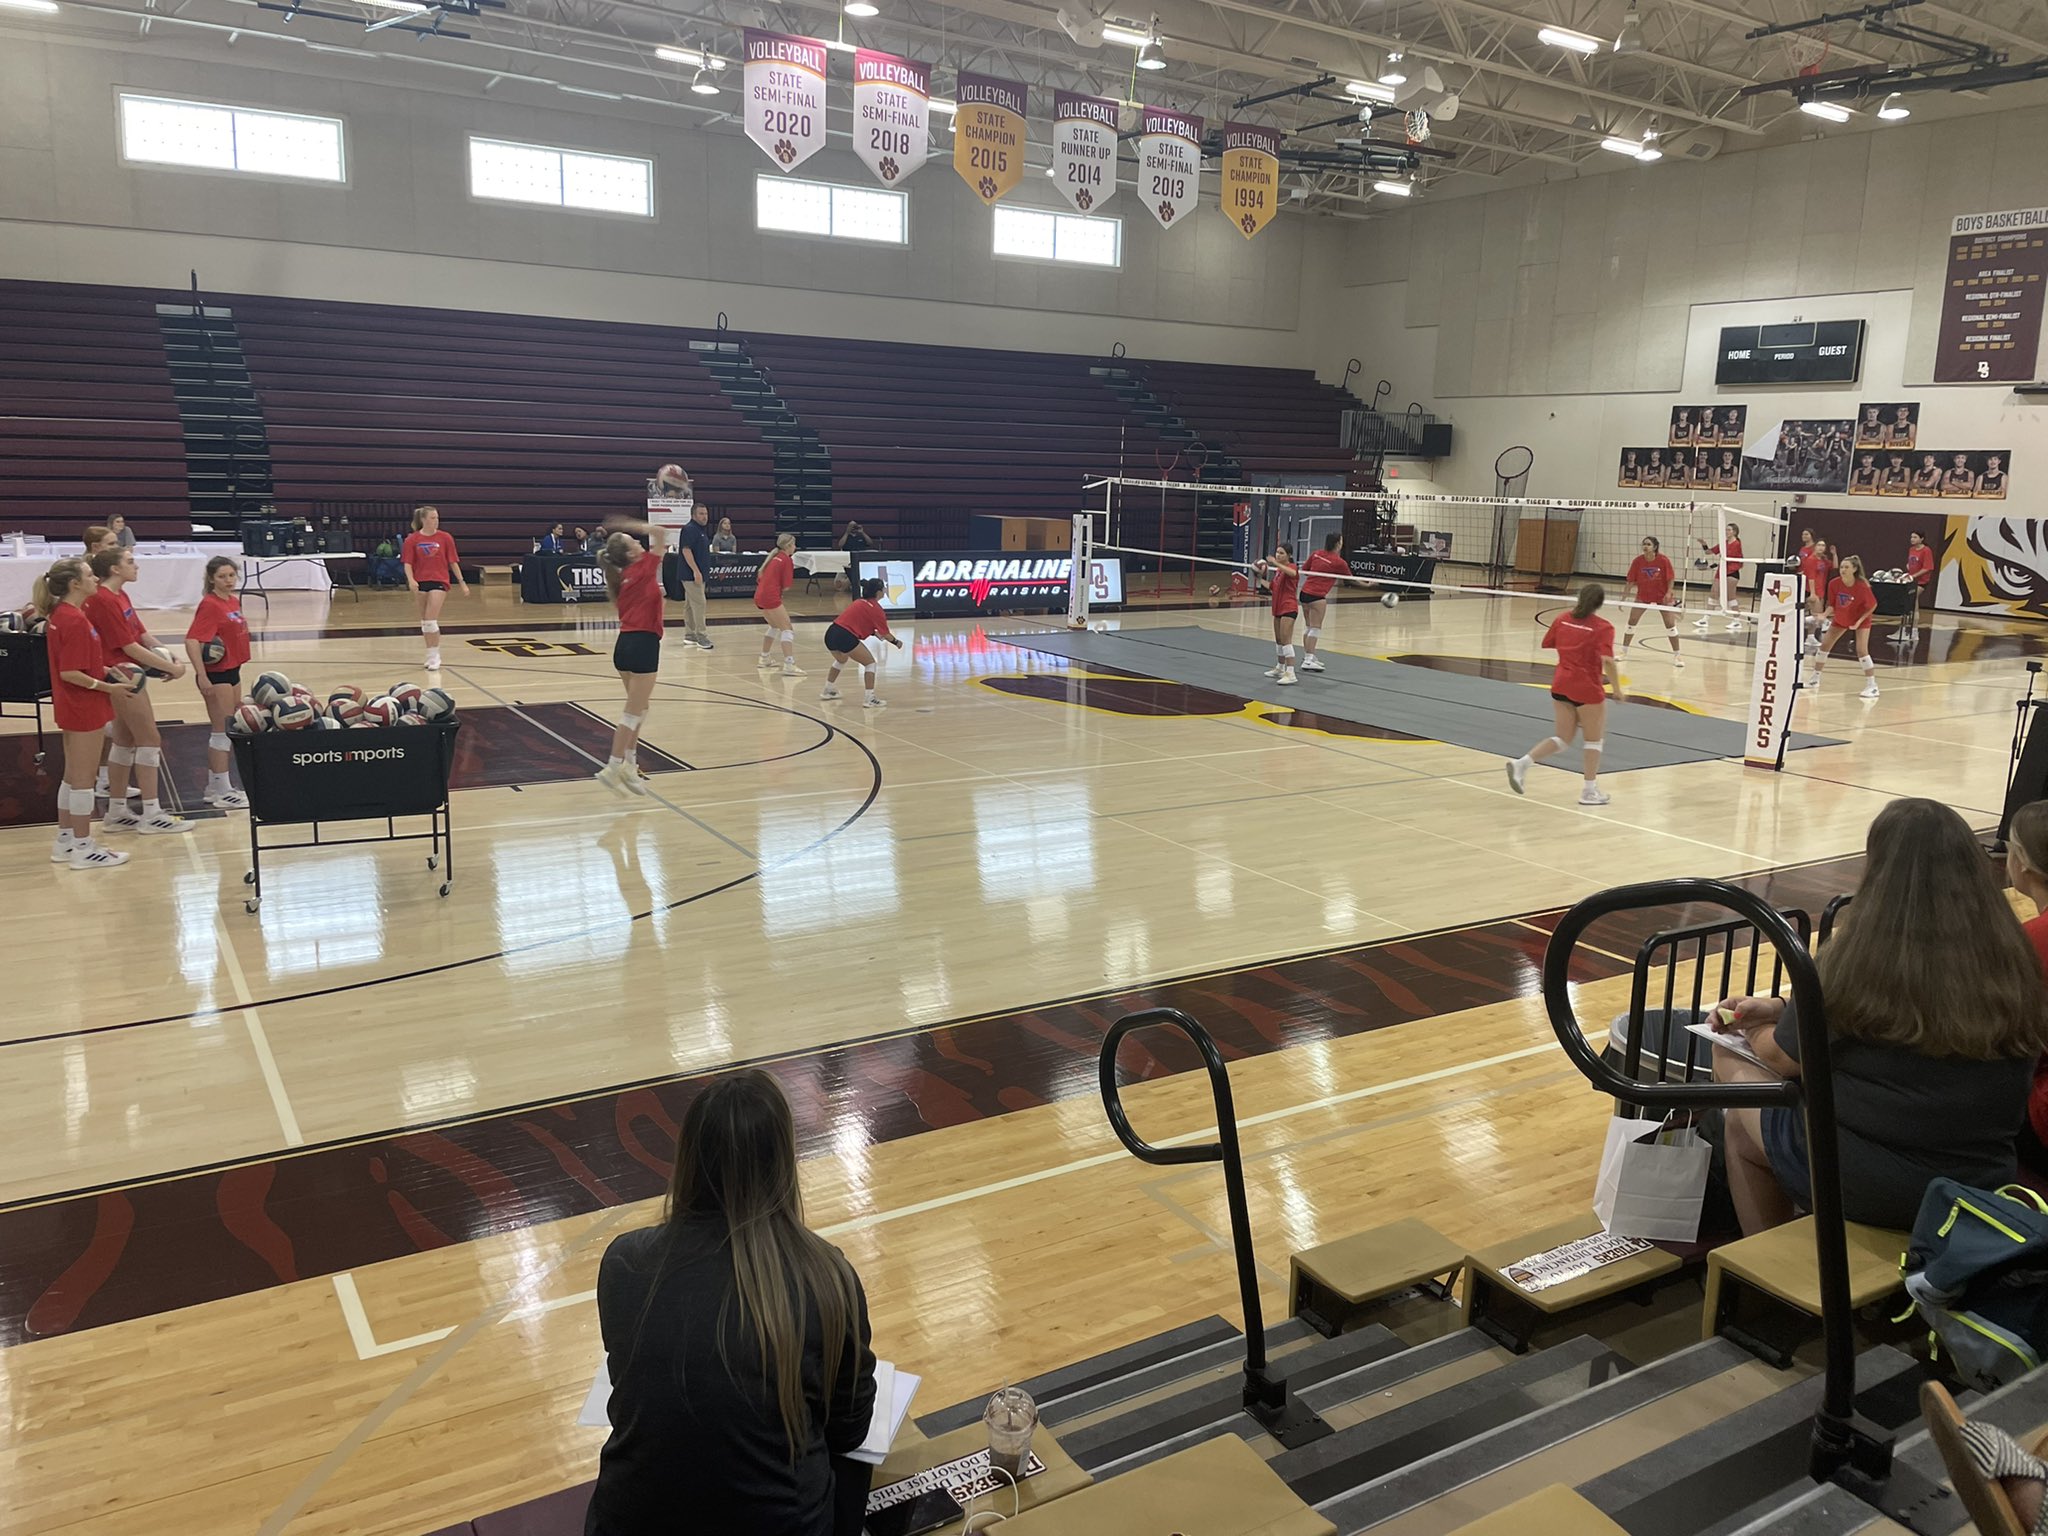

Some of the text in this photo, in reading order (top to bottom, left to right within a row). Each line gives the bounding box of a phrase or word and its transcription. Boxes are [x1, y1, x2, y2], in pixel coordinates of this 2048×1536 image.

[750, 41, 822, 72] VOLLEYBALL
[769, 70, 802, 90] STATE
[860, 62, 926, 94] VOLLEYBALL
[754, 86, 817, 109] SEMI-FINAL
[876, 92, 907, 110] STATE
[960, 84, 1022, 114] VOLLEYBALL
[764, 109, 811, 138] 2020
[862, 105, 920, 128] SEMI-FINAL
[977, 112, 1005, 128] STATE
[1058, 102, 1115, 128] VOLLEYBALL
[966, 125, 1016, 146] CHAMPION
[1073, 128, 1098, 144] STATE
[1146, 117, 1199, 144] VOLLEYBALL
[870, 128, 910, 155] 2018
[1062, 142, 1110, 160] RUNNER UP
[1159, 142, 1184, 158] STATE
[1226, 132, 1276, 156] VOLLEYBALL
[971, 146, 1007, 172] 2015
[1146, 156, 1194, 175] SEMI-FINAL
[1240, 156, 1262, 170] STATE
[1068, 162, 1102, 186] 2014
[1230, 169, 1270, 184] CHAMPION
[1152, 176, 1184, 199] 2013
[1235, 188, 1264, 208] 1994
[1956, 216, 1984, 232] BOYS
[1728, 350, 1752, 360] HOME
[1818, 346, 1848, 356] GUEST
[1482, 496, 1508, 504] SPRINGS
[1568, 500, 1602, 508] DRIPPING
[1658, 502, 1686, 510] TIGERS
[916, 559, 1072, 580] ADRENALINE
[1350, 560, 1376, 571] sports
[1757, 614, 1786, 749] TIGERS
[292, 747, 405, 766] sports imports
[1592, 1243, 1640, 1264] TIGERS
[1594, 1236, 1626, 1255] SOCIAL
[1533, 1250, 1592, 1275] DISTANCING
[932, 1462, 959, 1480] NOT
[960, 1456, 980, 1468] DO
[872, 1481, 905, 1500] THIS
[906, 1472, 930, 1489] USE
